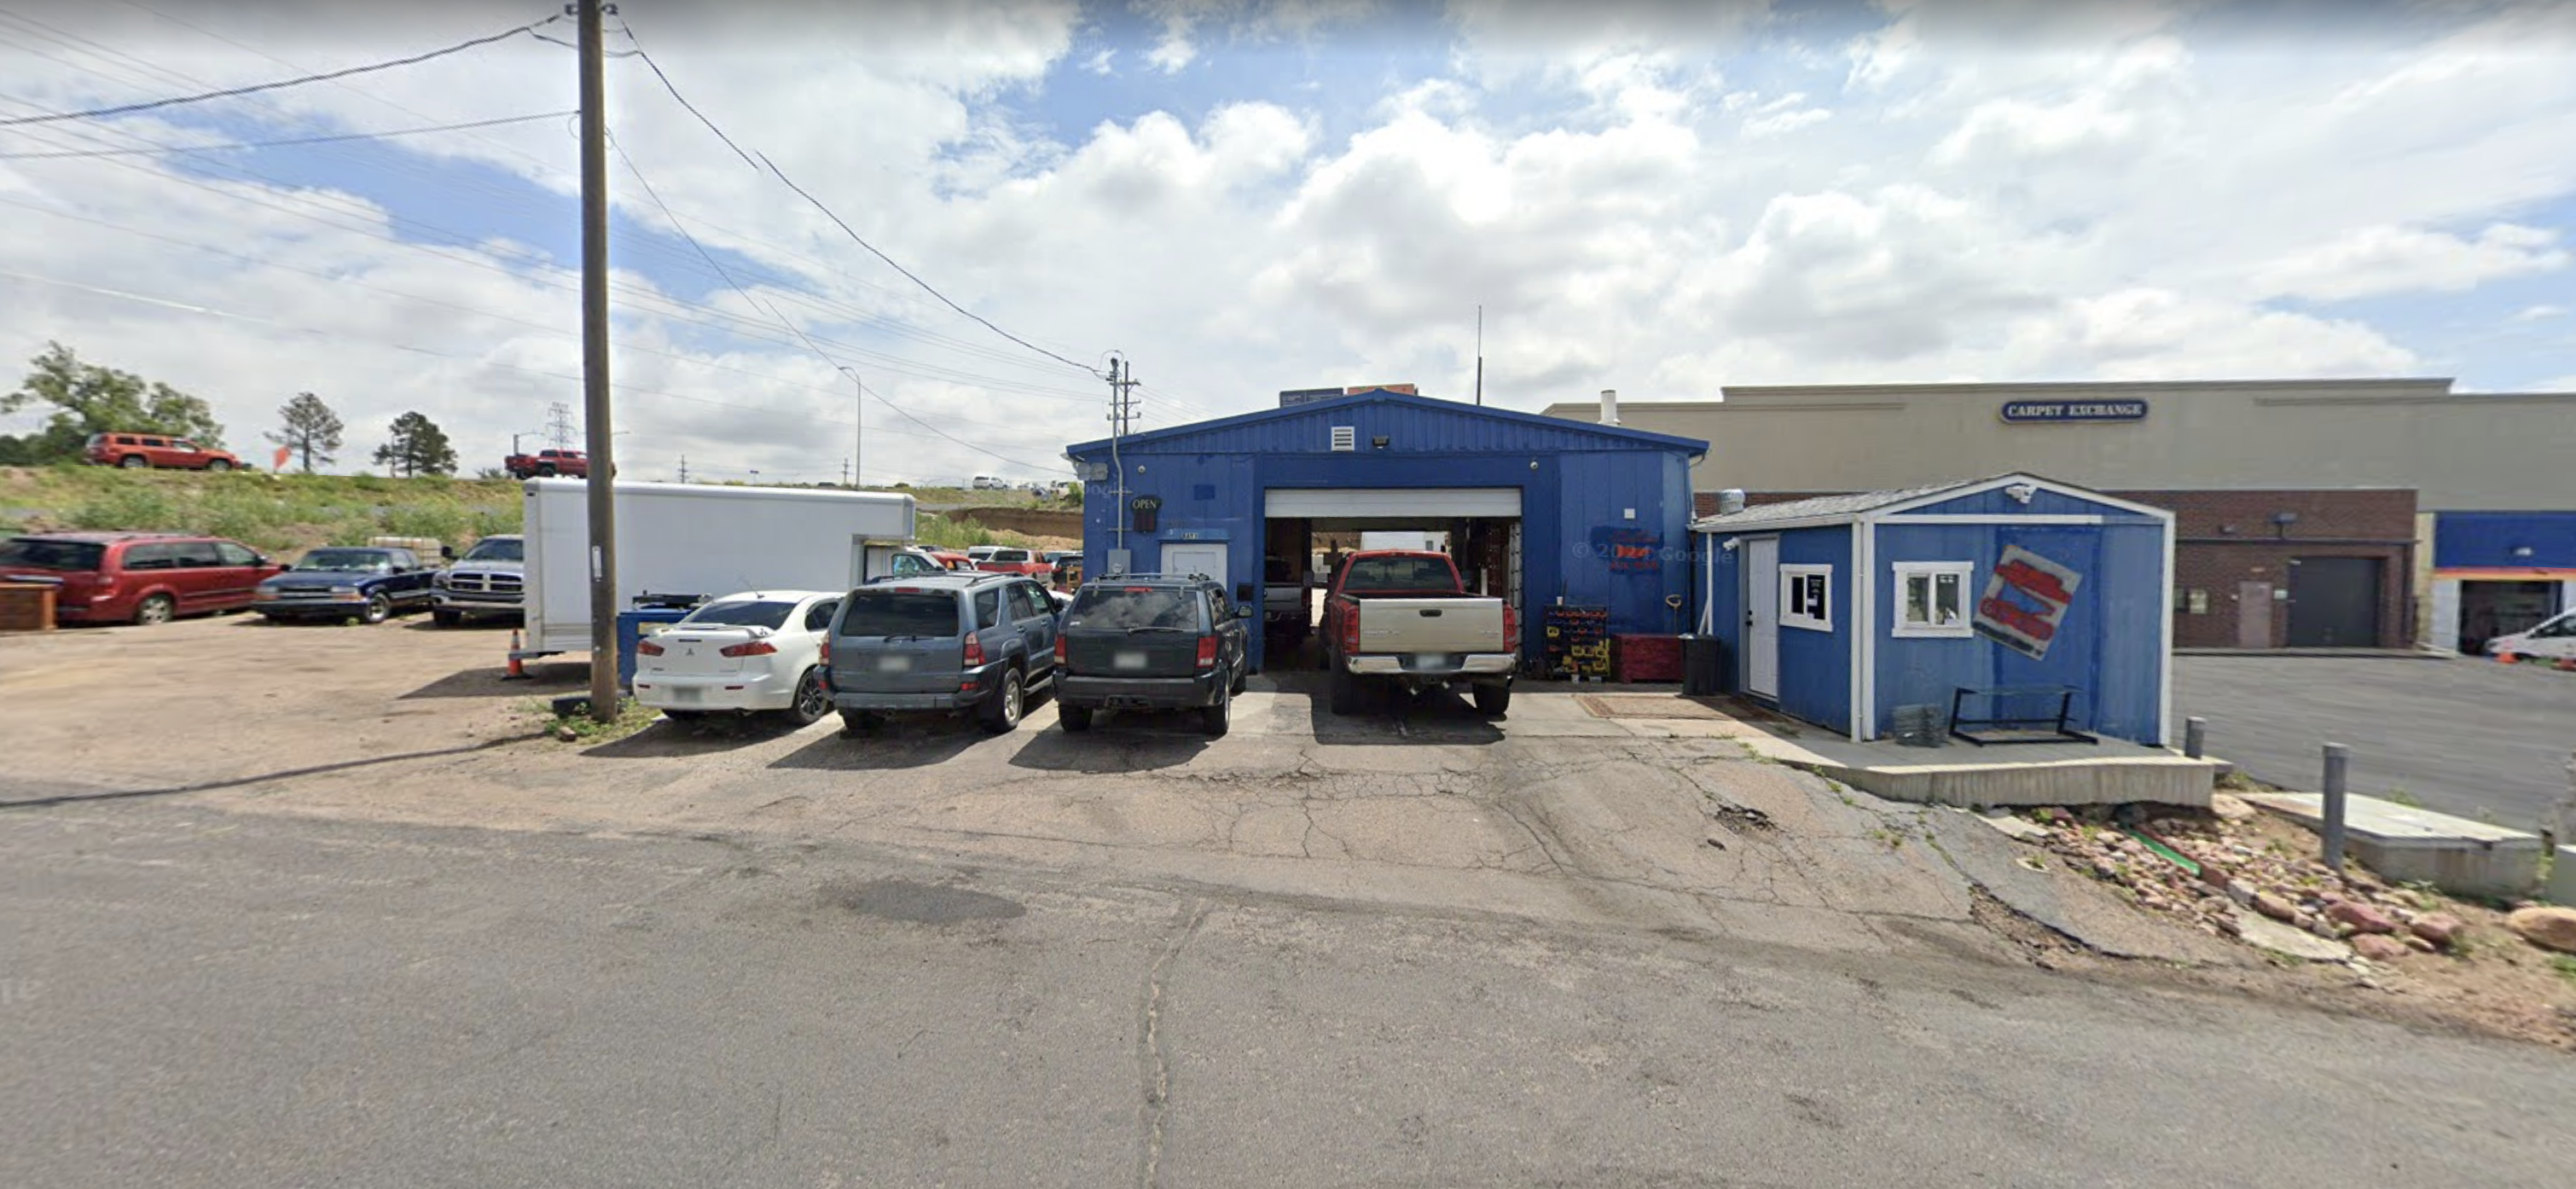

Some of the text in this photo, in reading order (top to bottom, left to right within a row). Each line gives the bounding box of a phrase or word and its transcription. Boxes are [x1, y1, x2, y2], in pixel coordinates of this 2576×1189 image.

[2007, 403, 2143, 417] CARPET EXCHANGE
[1132, 499, 1157, 510] OPEN
